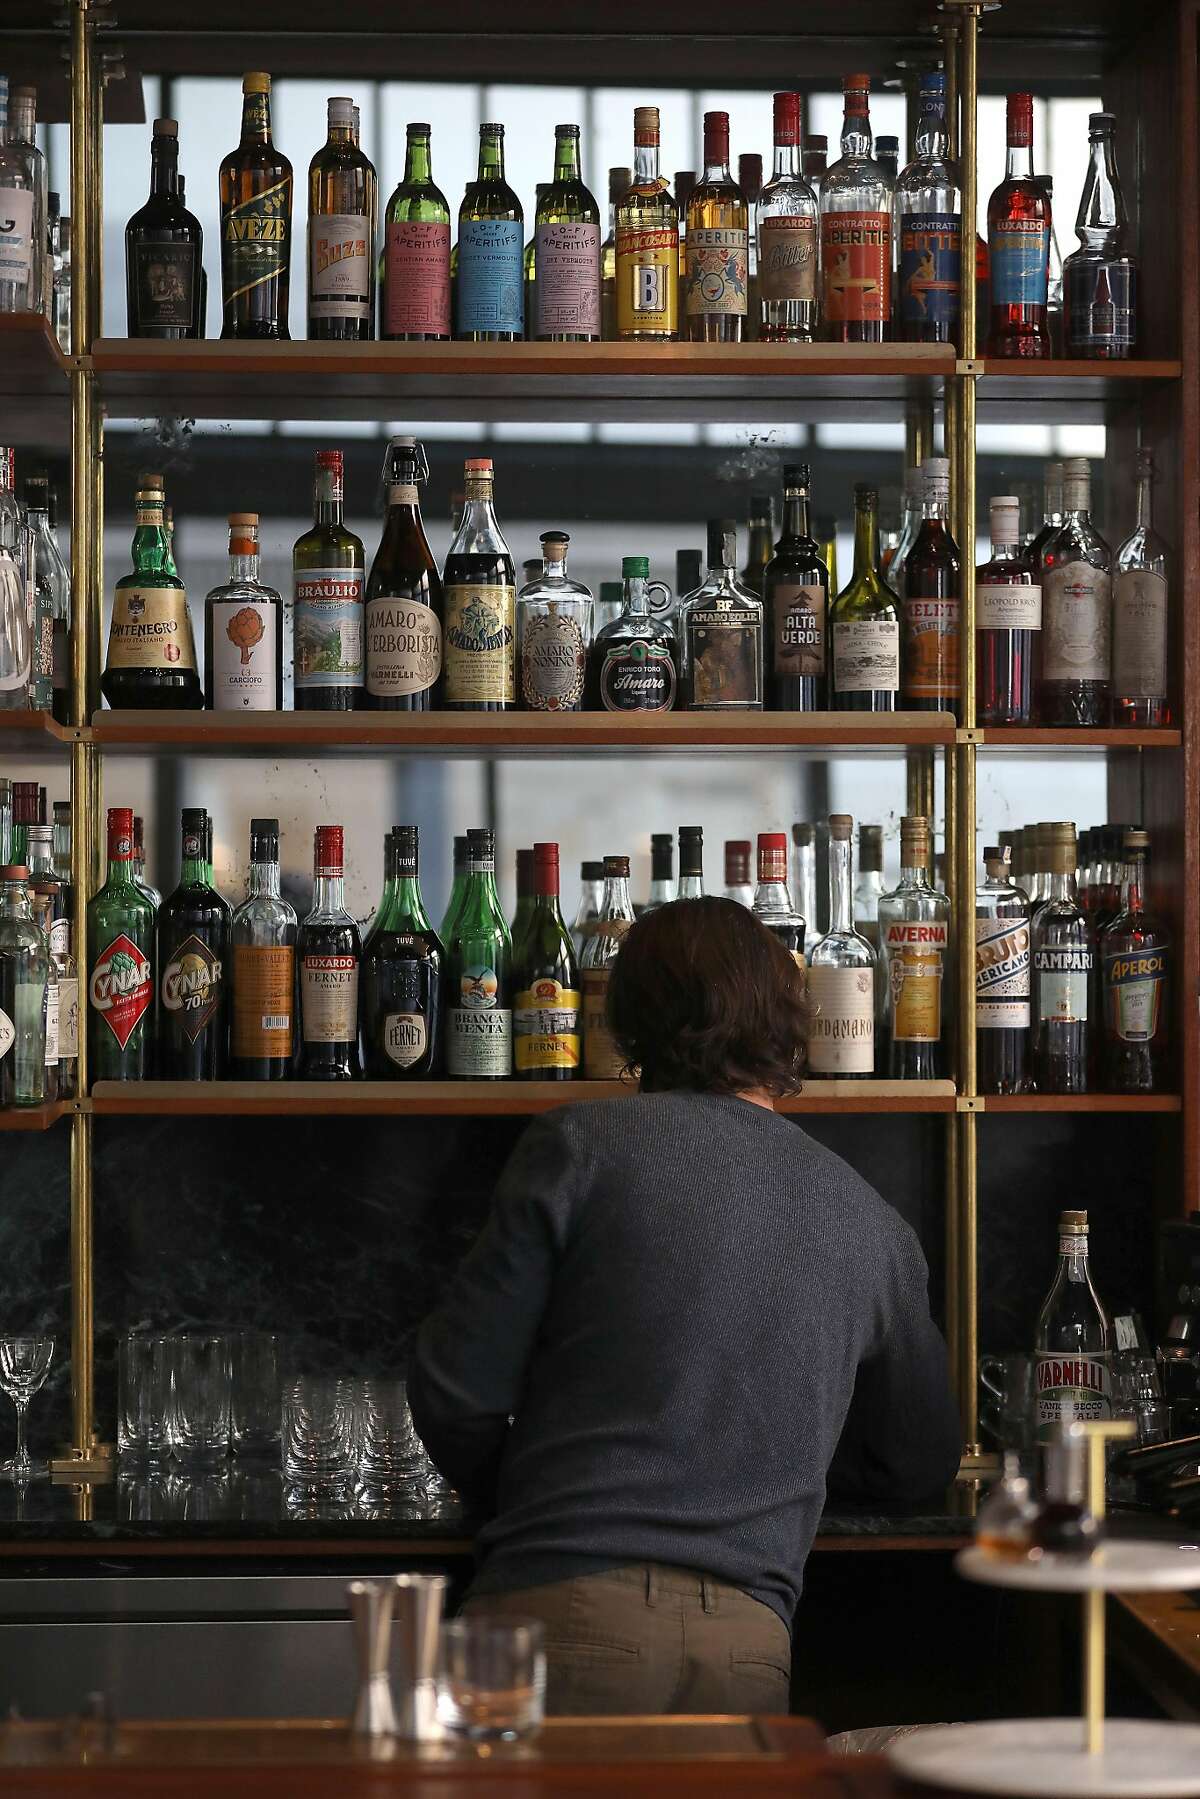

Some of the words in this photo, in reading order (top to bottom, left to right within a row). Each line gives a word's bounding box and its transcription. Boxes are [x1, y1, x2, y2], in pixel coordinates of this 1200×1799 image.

[473, 224, 507, 234] LO-FI
[828, 219, 880, 229] CONTRATTO
[996, 221, 1044, 232] LUXARDO
[403, 226, 438, 235] LO-FI
[552, 226, 586, 236] LO-FI
[394, 236, 448, 249] APERITIFS
[465, 234, 518, 247] APERITIFS
[544, 237, 597, 250] APERITIFS
[317, 239, 365, 273] Suze
[562, 257, 594, 265] VERMOUTH
[639, 269, 659, 308] B
[298, 585, 358, 597] BRAULIO
[369, 610, 416, 629] AMARO
[692, 612, 726, 622] AMARO
[728, 612, 758, 622] EOLIE
[786, 616, 816, 629] ALTA
[782, 631, 821, 645] VERDE
[534, 646, 575, 656] AMARO
[533, 657, 575, 668] NONINO
[614, 674, 665, 690] Amaro
[888, 926, 946, 943] AVERNA
[306, 957, 353, 968] LUXARDO
[1034, 951, 1093, 970] CAMPARI
[1111, 956, 1165, 980] APEROL
[307, 971, 353, 983] FERNET
[89, 961, 151, 1011] CYNAR
[161, 961, 222, 1011] CYNAR
[455, 1014, 504, 1024] BRANCA
[455, 1024, 504, 1033] MENTA
[390, 1024, 421, 1046] FERNET
[528, 1042, 568, 1052] FERNET
[1038, 1360, 1103, 1393] VARNELLI
[1073, 1402, 1103, 1411] SECCO
